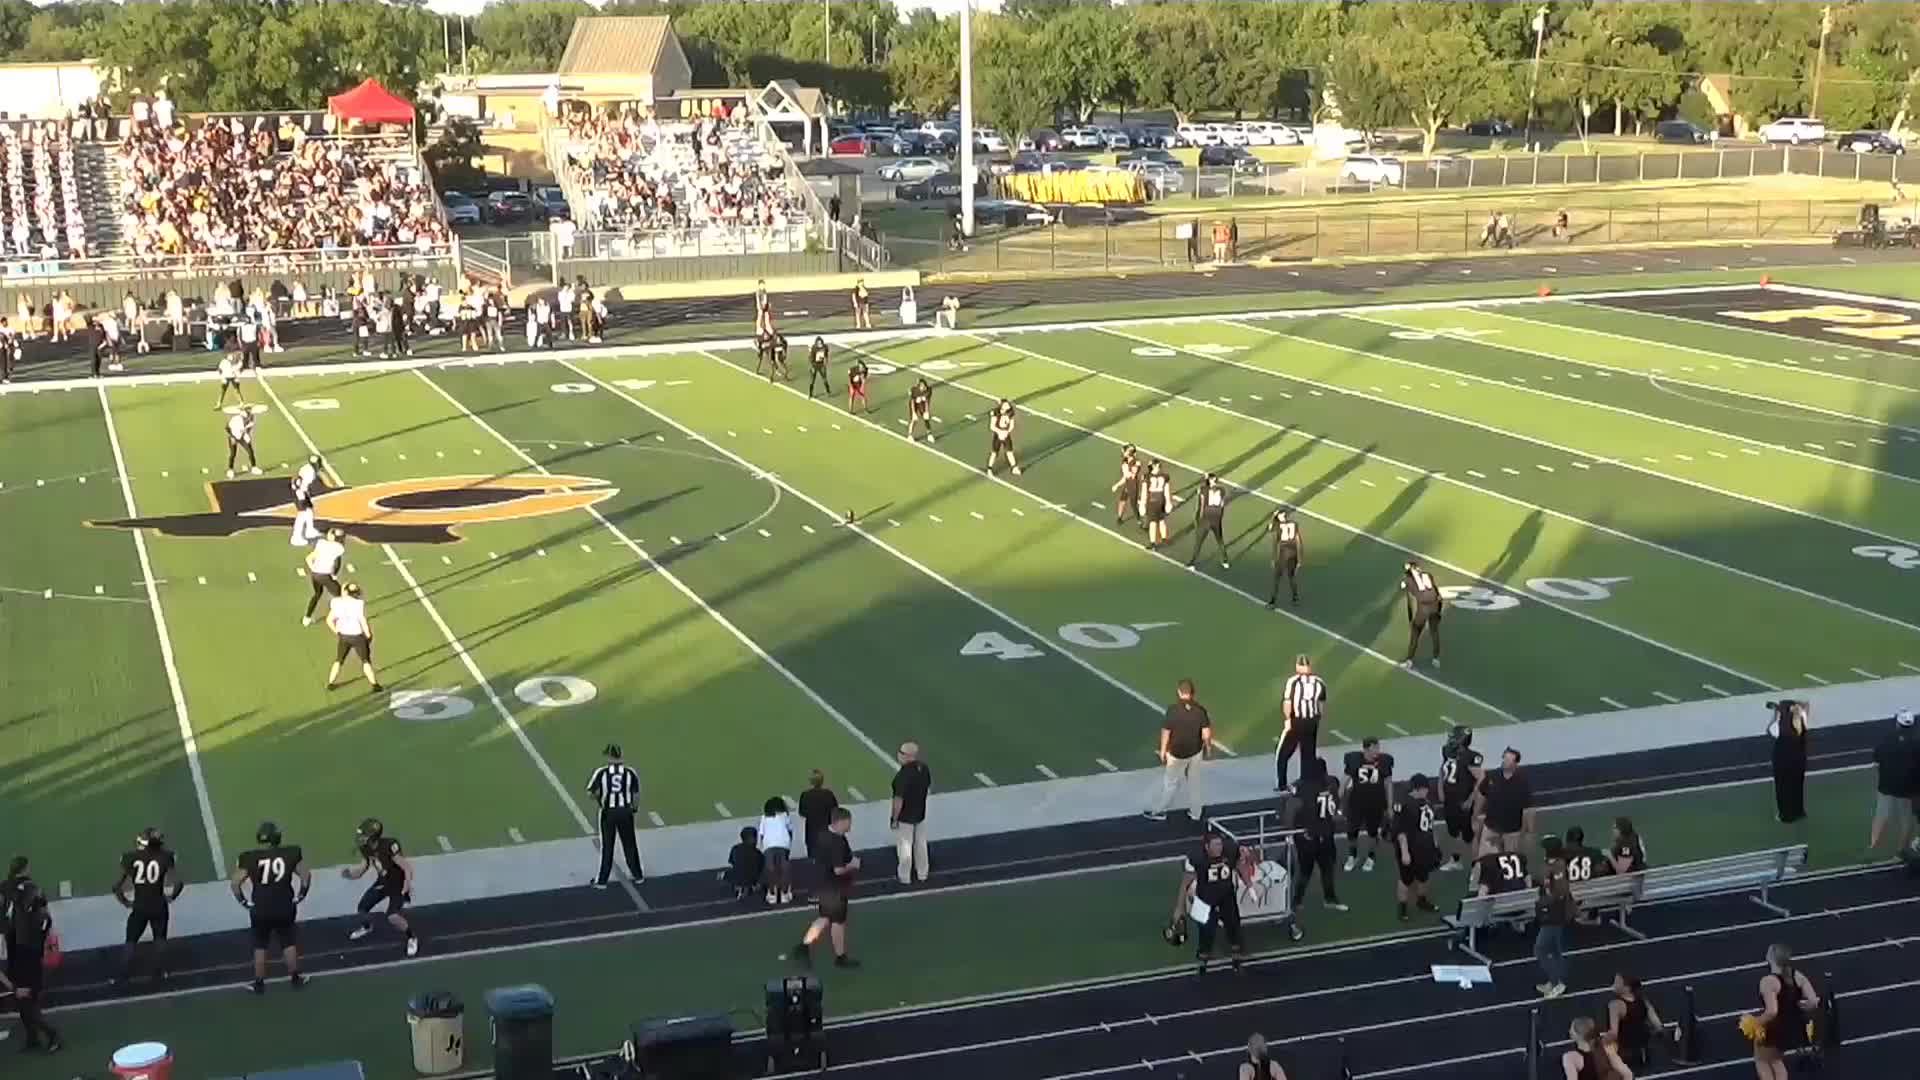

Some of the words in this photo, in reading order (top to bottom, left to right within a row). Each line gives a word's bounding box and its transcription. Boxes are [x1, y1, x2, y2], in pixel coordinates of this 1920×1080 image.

[611, 774, 622, 792] S
[133, 860, 159, 884] 20
[258, 858, 285, 884] 79
[1568, 857, 1591, 880] 68
